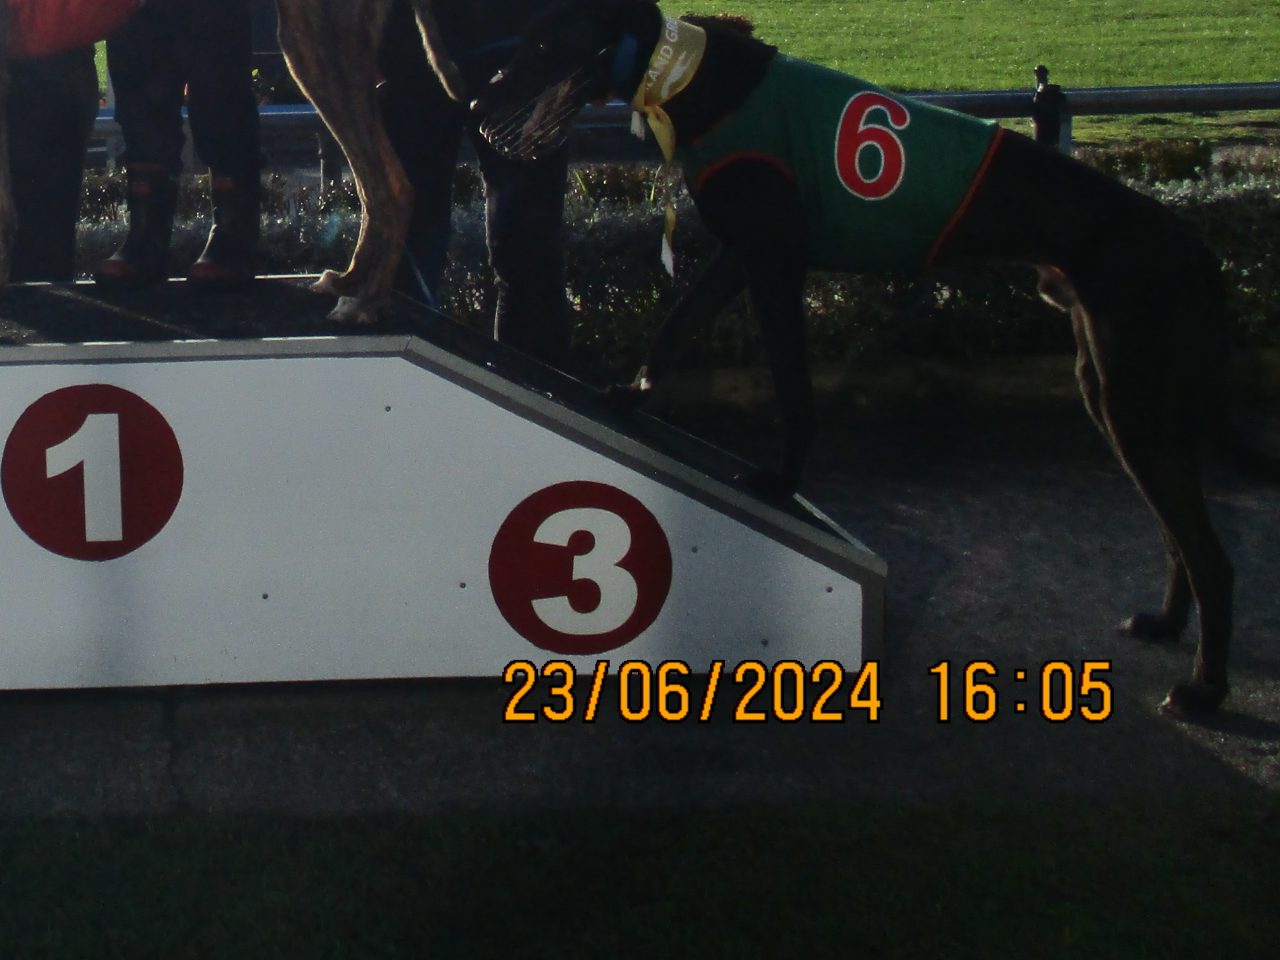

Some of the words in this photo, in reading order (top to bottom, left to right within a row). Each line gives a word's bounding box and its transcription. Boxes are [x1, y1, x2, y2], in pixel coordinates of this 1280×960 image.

[834, 91, 911, 201] 6
[46, 413, 123, 543] 1
[531, 507, 639, 636] 3
